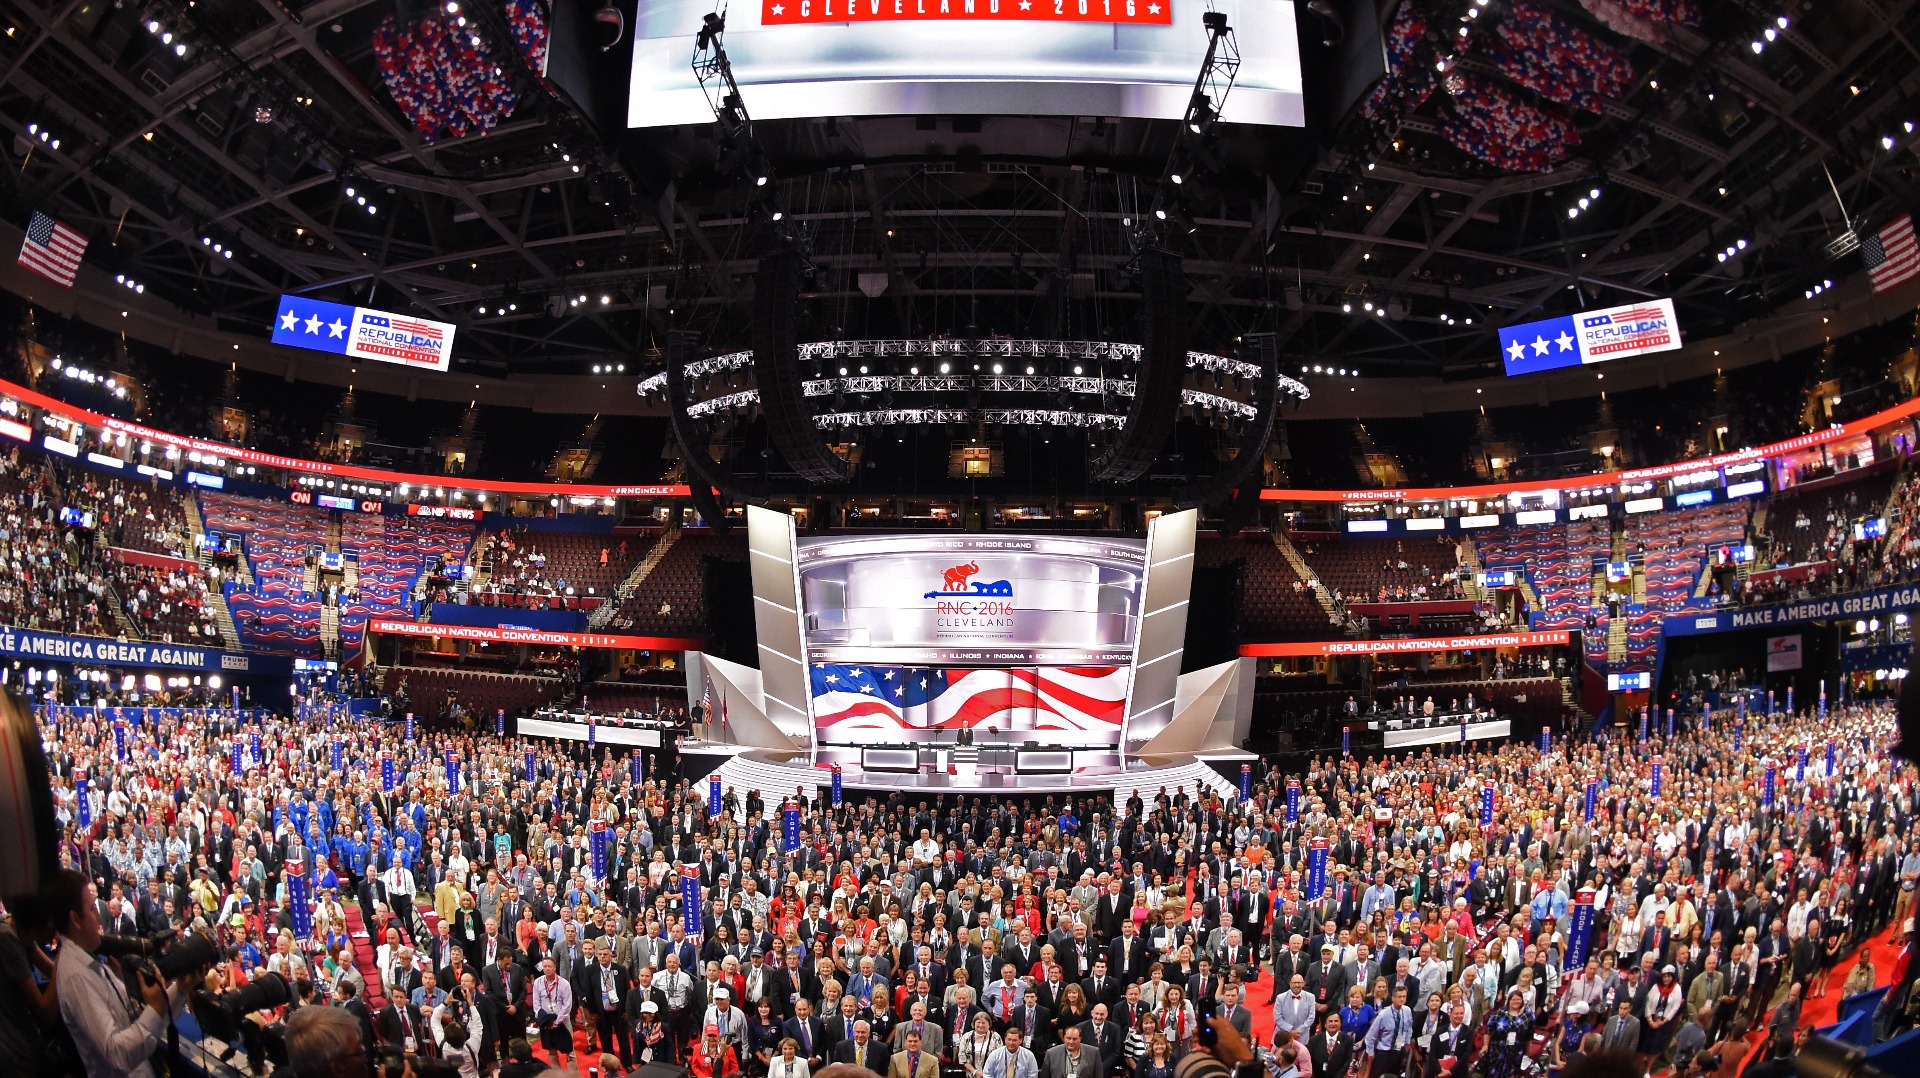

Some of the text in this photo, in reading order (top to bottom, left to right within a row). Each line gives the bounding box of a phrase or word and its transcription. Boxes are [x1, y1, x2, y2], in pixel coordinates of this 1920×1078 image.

[801, 0, 1136, 17] CLEVELAND 2016
[359, 327, 442, 349] REPUBLICAN
[1586, 319, 1667, 340] REPUBLICAN
[1588, 329, 1669, 345] NATIONAL CONVENTION
[358, 336, 441, 355] NATIONAL CONVENTION
[107, 419, 154, 438] REPUBLICAN
[155, 430, 191, 447] NATIONAL
[192, 441, 243, 457] CONVENTION
[1622, 467, 1673, 479] REPUBLICAN
[1674, 459, 1713, 471] NATIONAL
[1712, 449, 1764, 465] CONVENTION
[290, 491, 311, 504] CNN
[450, 508, 475, 520] NEWS
[1110, 550, 1130, 558] SOUTH
[937, 601, 1014, 616] RNC 2016
[1733, 610, 1772, 627] MAKE
[1777, 602, 1840, 622] AMERICA
[1843, 594, 1888, 613] GREAT
[381, 622, 446, 635] REPUBLICAN
[448, 628, 500, 639] NATIONAL
[502, 631, 569, 644] CONVENTION
[937, 618, 1014, 627] CLEVELAND
[20, 636, 93, 659] AMERICA
[96, 643, 146, 663] GREAT
[150, 648, 205, 667] AGAIN!
[1329, 642, 1395, 653] REPUBLICAN
[1397, 640, 1450, 650] NATIONAL
[1451, 636, 1519, 648] CONVENTION
[222, 655, 248, 663] TRUMP
[80, 787, 88, 815] GUAM
[290, 877, 302, 933] VIRGINIA
[686, 878, 694, 930] TENNESSEE
[1571, 905, 1588, 965] RHODE ISLAND
